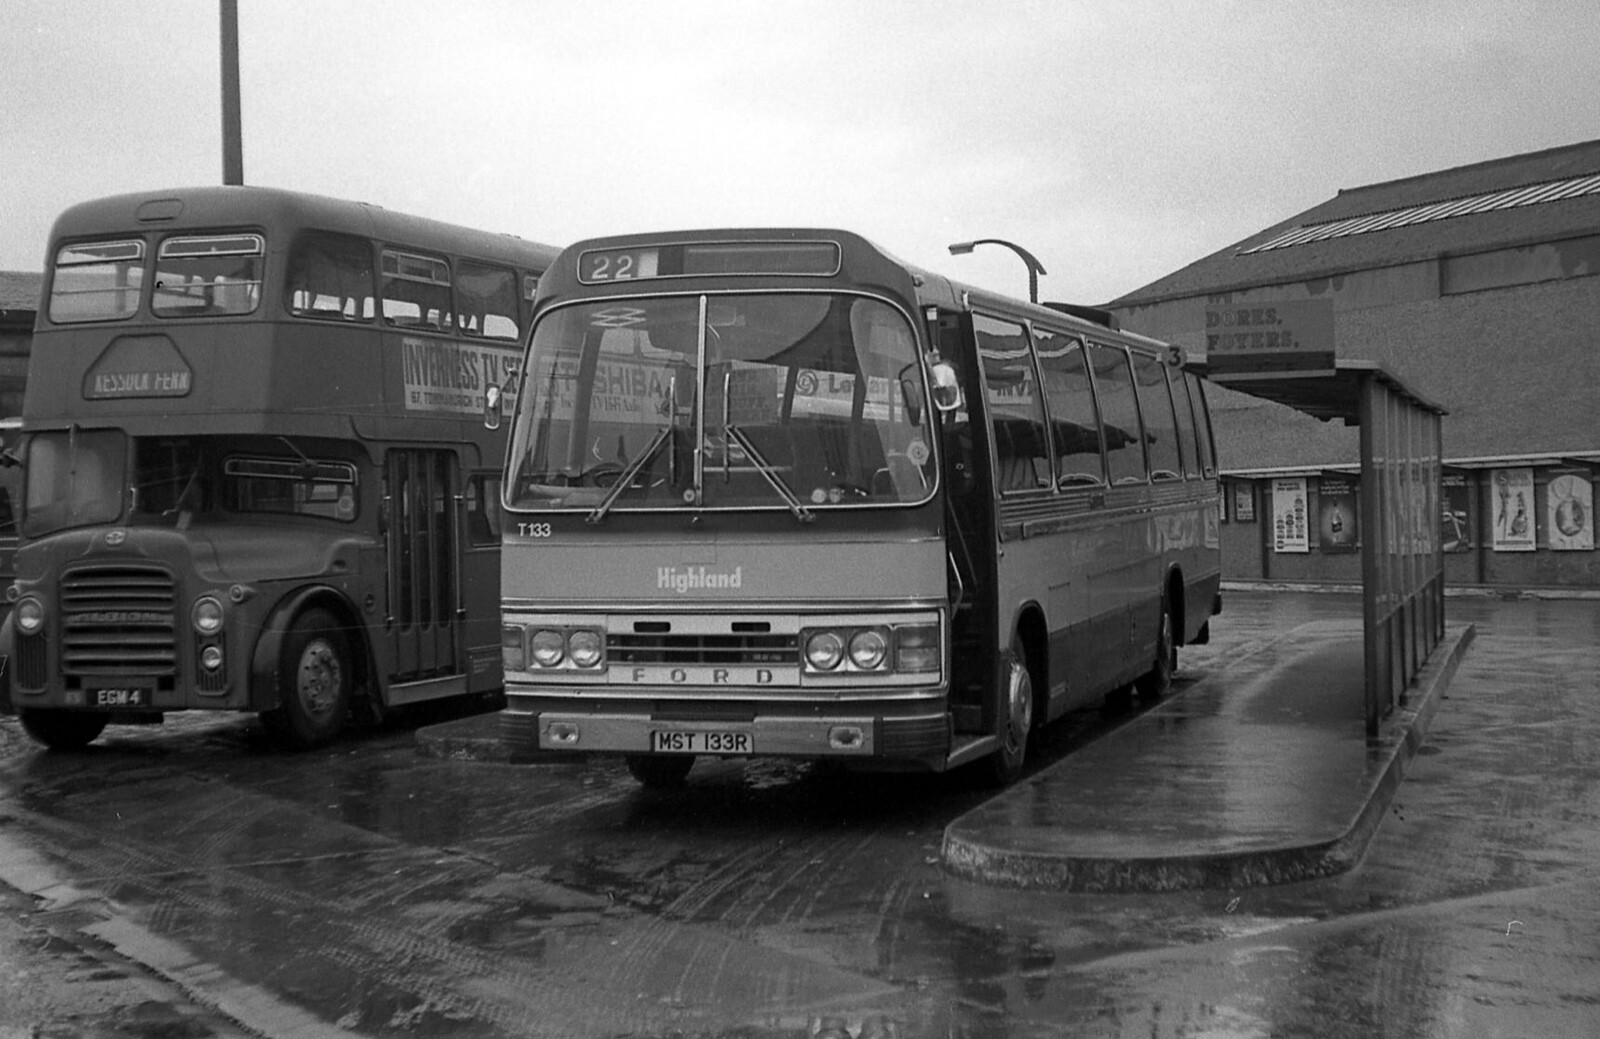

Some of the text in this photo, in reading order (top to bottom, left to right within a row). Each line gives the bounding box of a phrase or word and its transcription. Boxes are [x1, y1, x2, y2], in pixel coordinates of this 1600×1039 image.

[592, 254, 632, 280] 22
[1168, 347, 1181, 366] 3
[404, 344, 480, 391] INVERNESS
[481, 353, 498, 386] TV
[657, 566, 742, 593] Highland
[632, 668, 774, 686] FORD
[98, 690, 127, 705] EGM
[129, 690, 140, 705] 4
[658, 732, 748, 752] MST 133R
